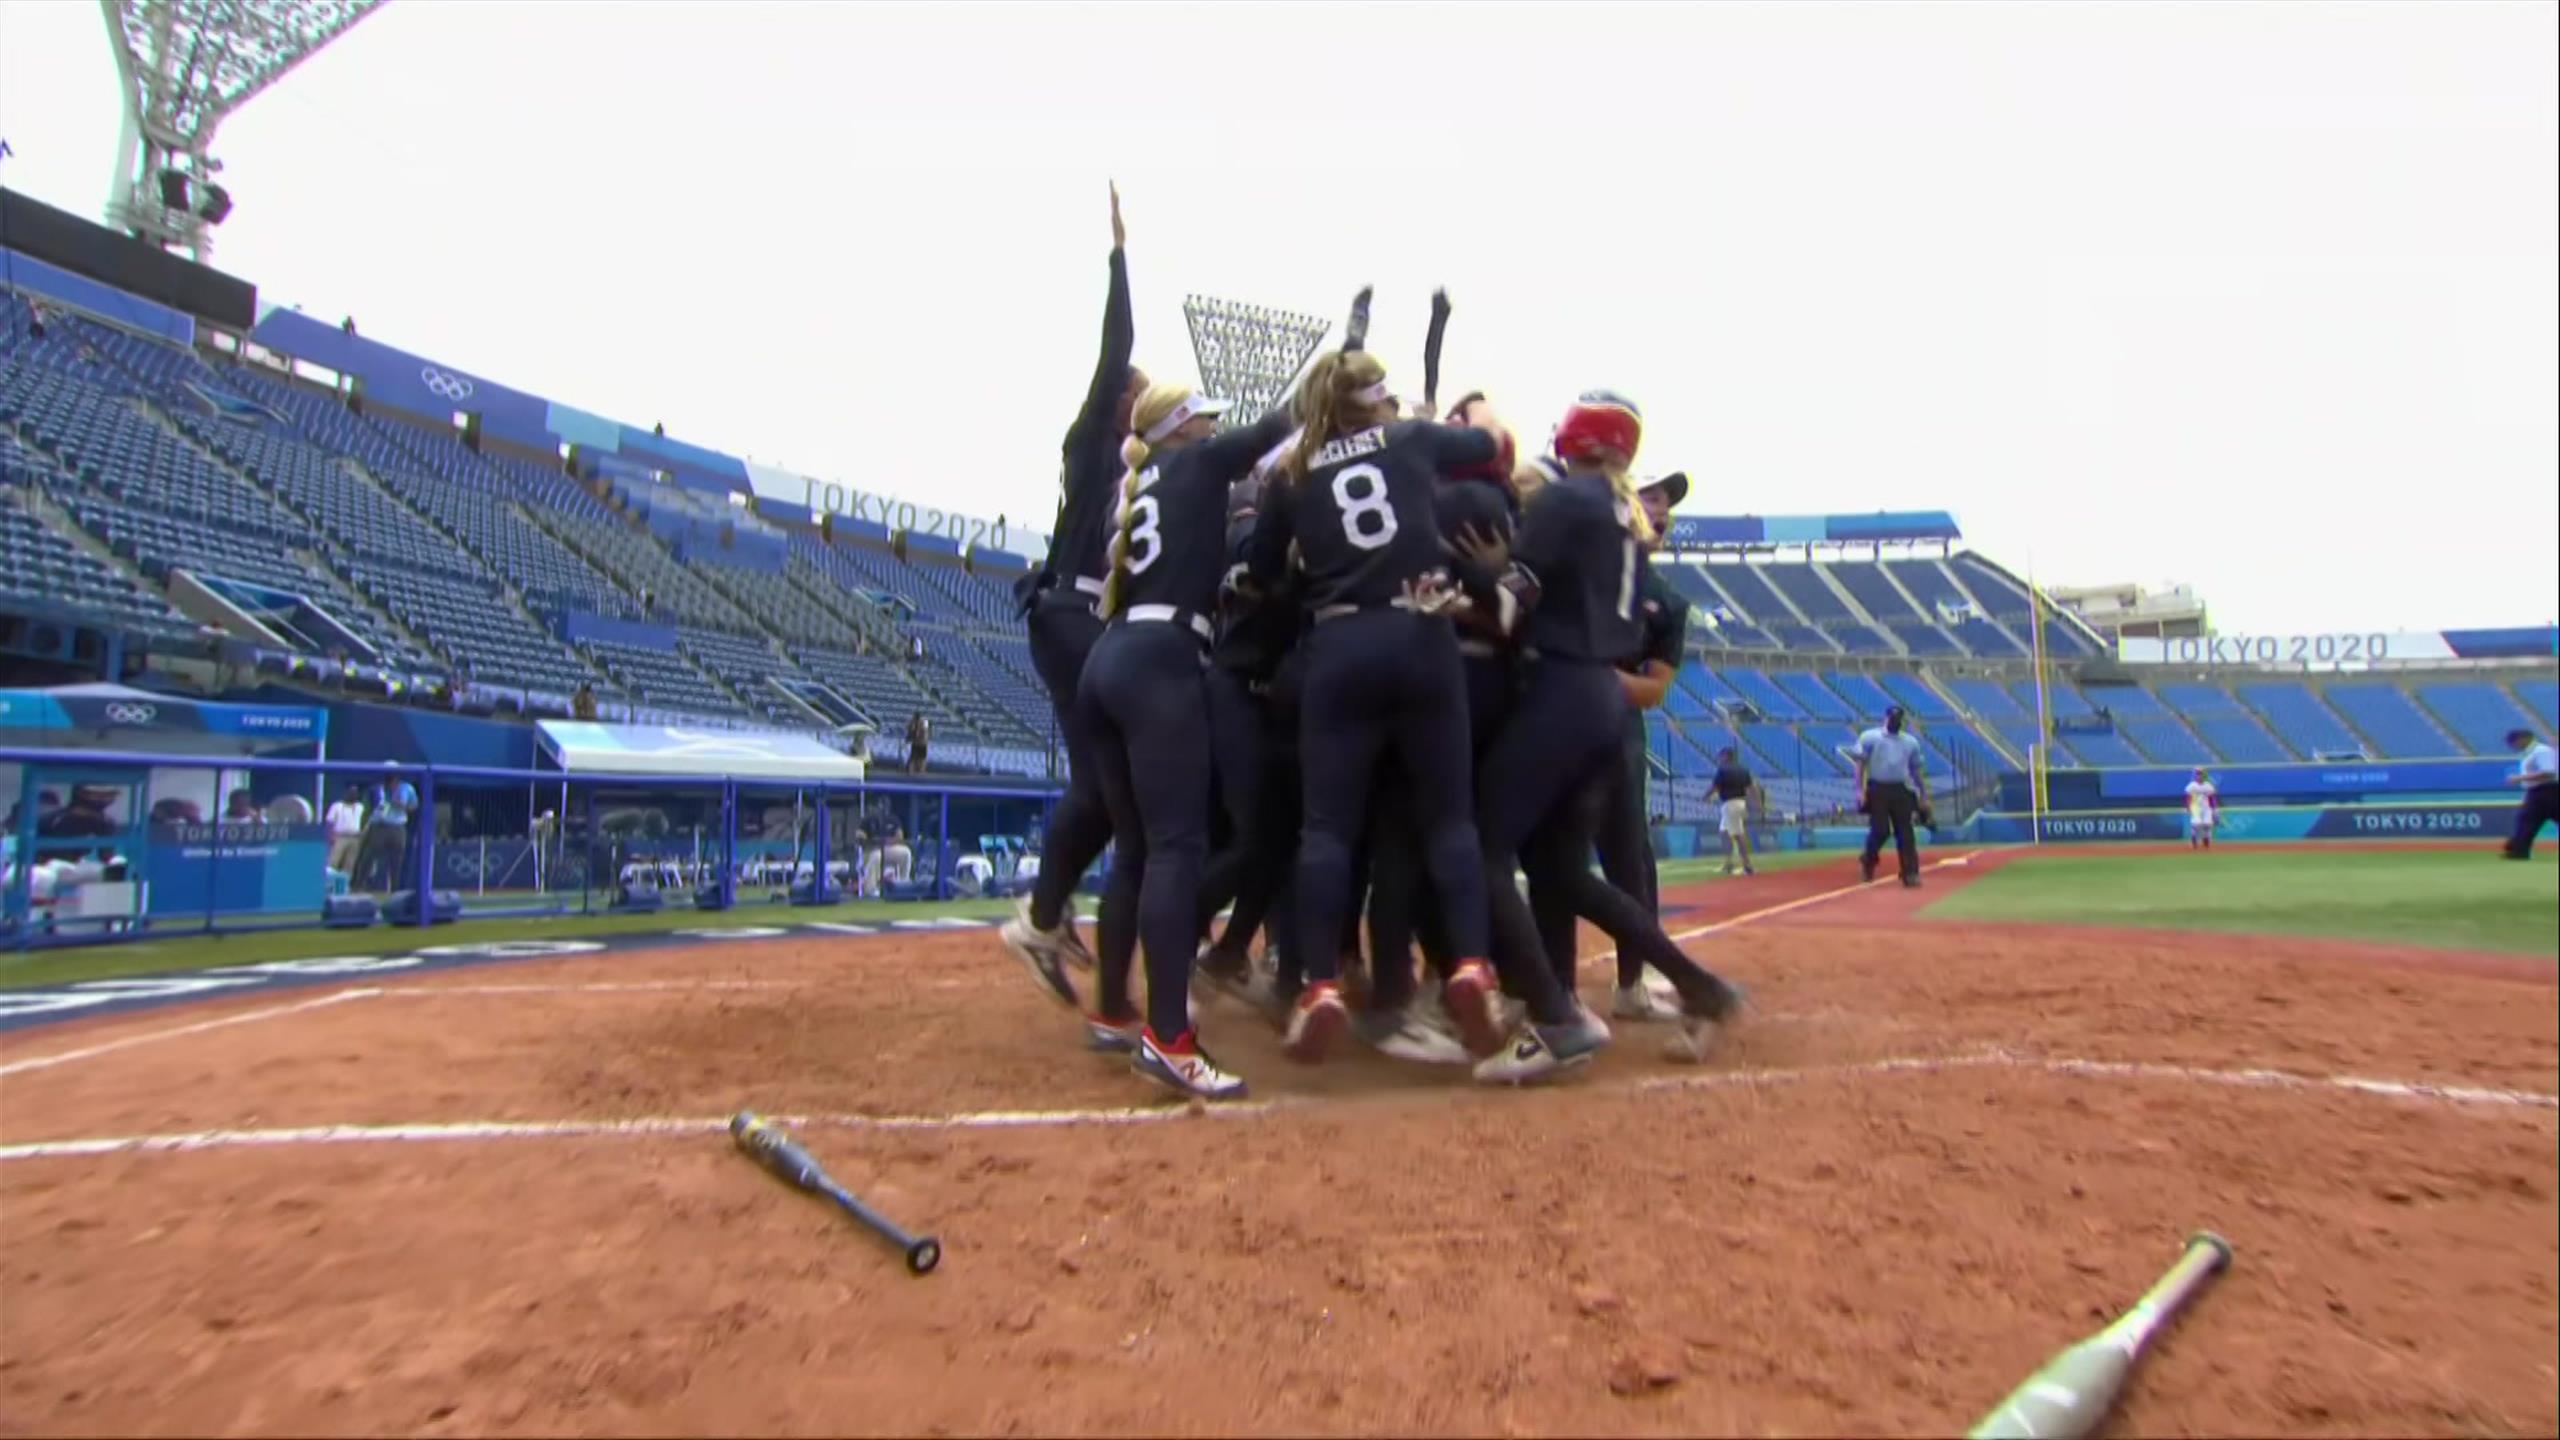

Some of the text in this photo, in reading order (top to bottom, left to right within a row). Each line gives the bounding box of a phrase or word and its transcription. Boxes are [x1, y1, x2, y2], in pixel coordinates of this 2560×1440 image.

[801, 475, 1007, 550] TOKYO 2020
[1331, 462, 1398, 549] 8
[1126, 495, 1162, 575] 3
[2161, 633, 2388, 664] TOKYO 2020
[2046, 818, 2137, 834] TOKYO 2020
[2353, 812, 2482, 831] TOKYO 2020
